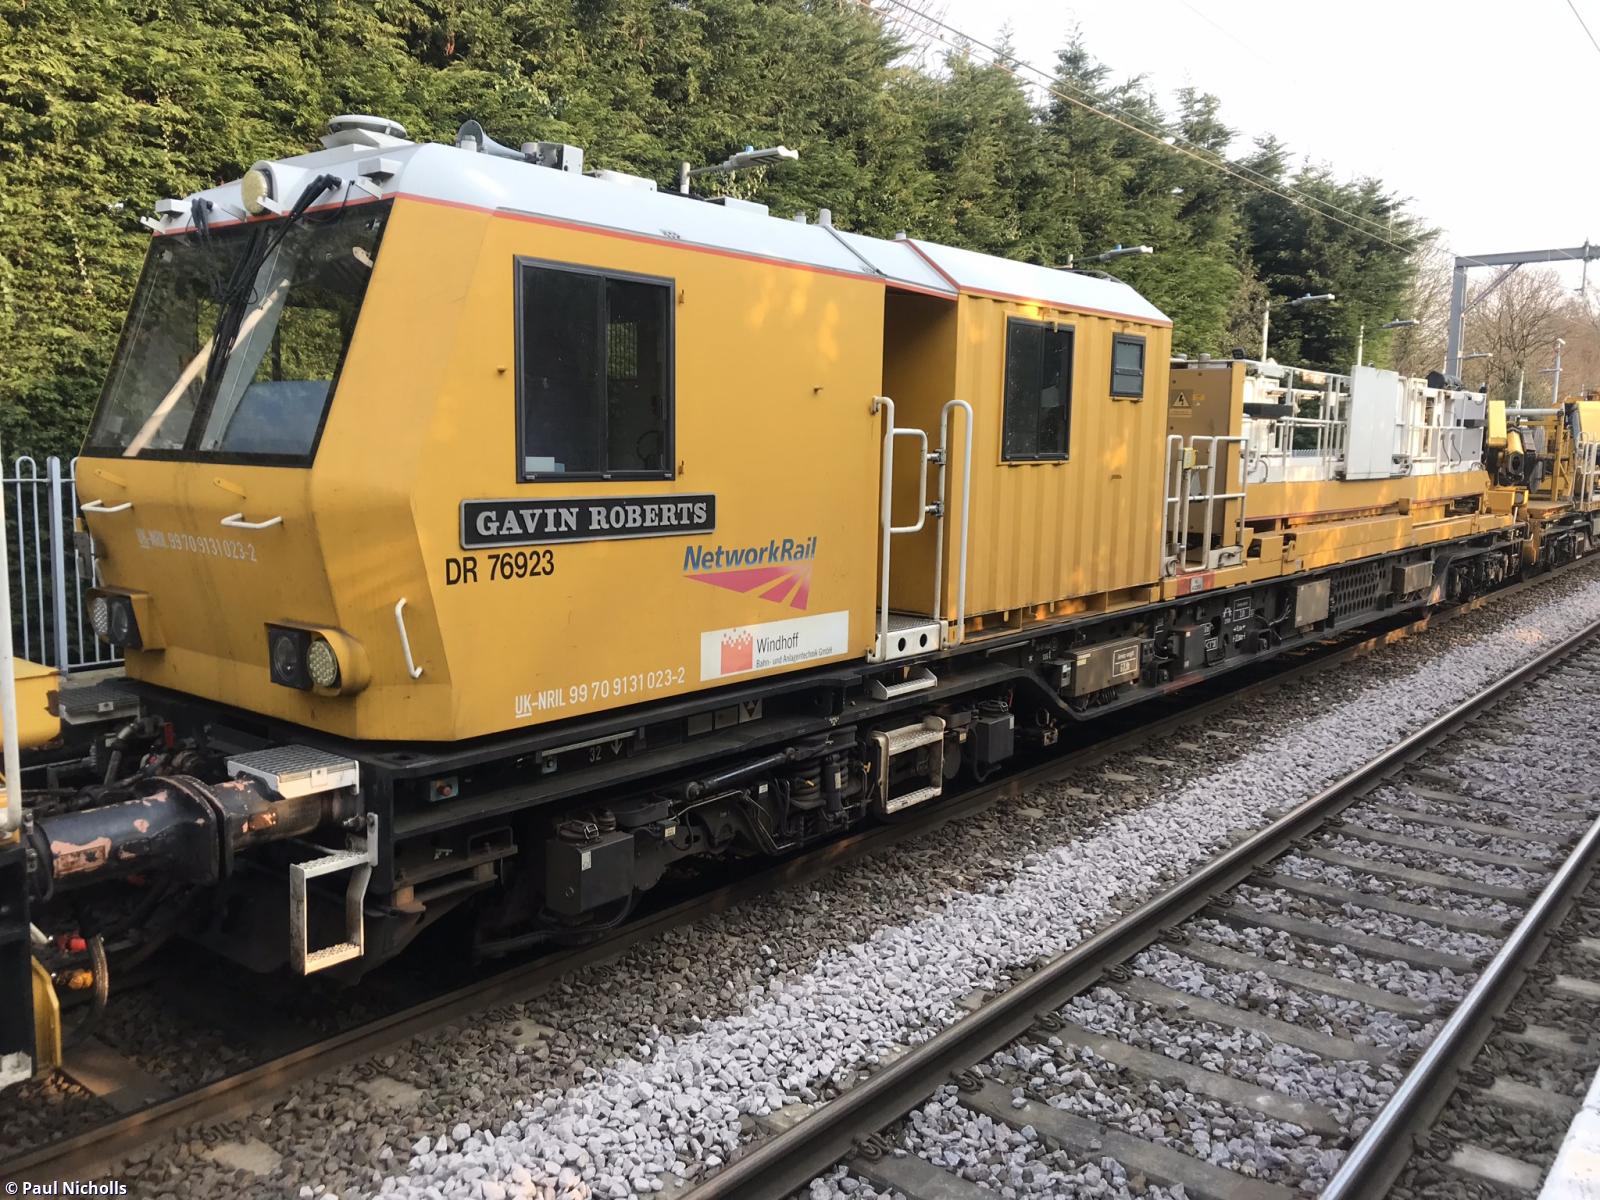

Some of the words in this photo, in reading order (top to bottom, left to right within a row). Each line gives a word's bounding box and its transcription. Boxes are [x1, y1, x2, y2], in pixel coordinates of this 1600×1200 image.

[476, 508, 579, 536] GAVIN
[588, 502, 707, 530] ROBERTS
[223, 540, 257, 562] 023-2
[445, 557, 478, 585] DR
[487, 550, 555, 581] 76923
[756, 632, 799, 653] Windhoff
[773, 655, 783, 665] und
[515, 687, 566, 718] UK-NRIL
[569, 684, 588, 704] 99
[591, 680, 609, 699] 70
[613, 673, 643, 696] 9131
[647, 666, 686, 689] 023-2
